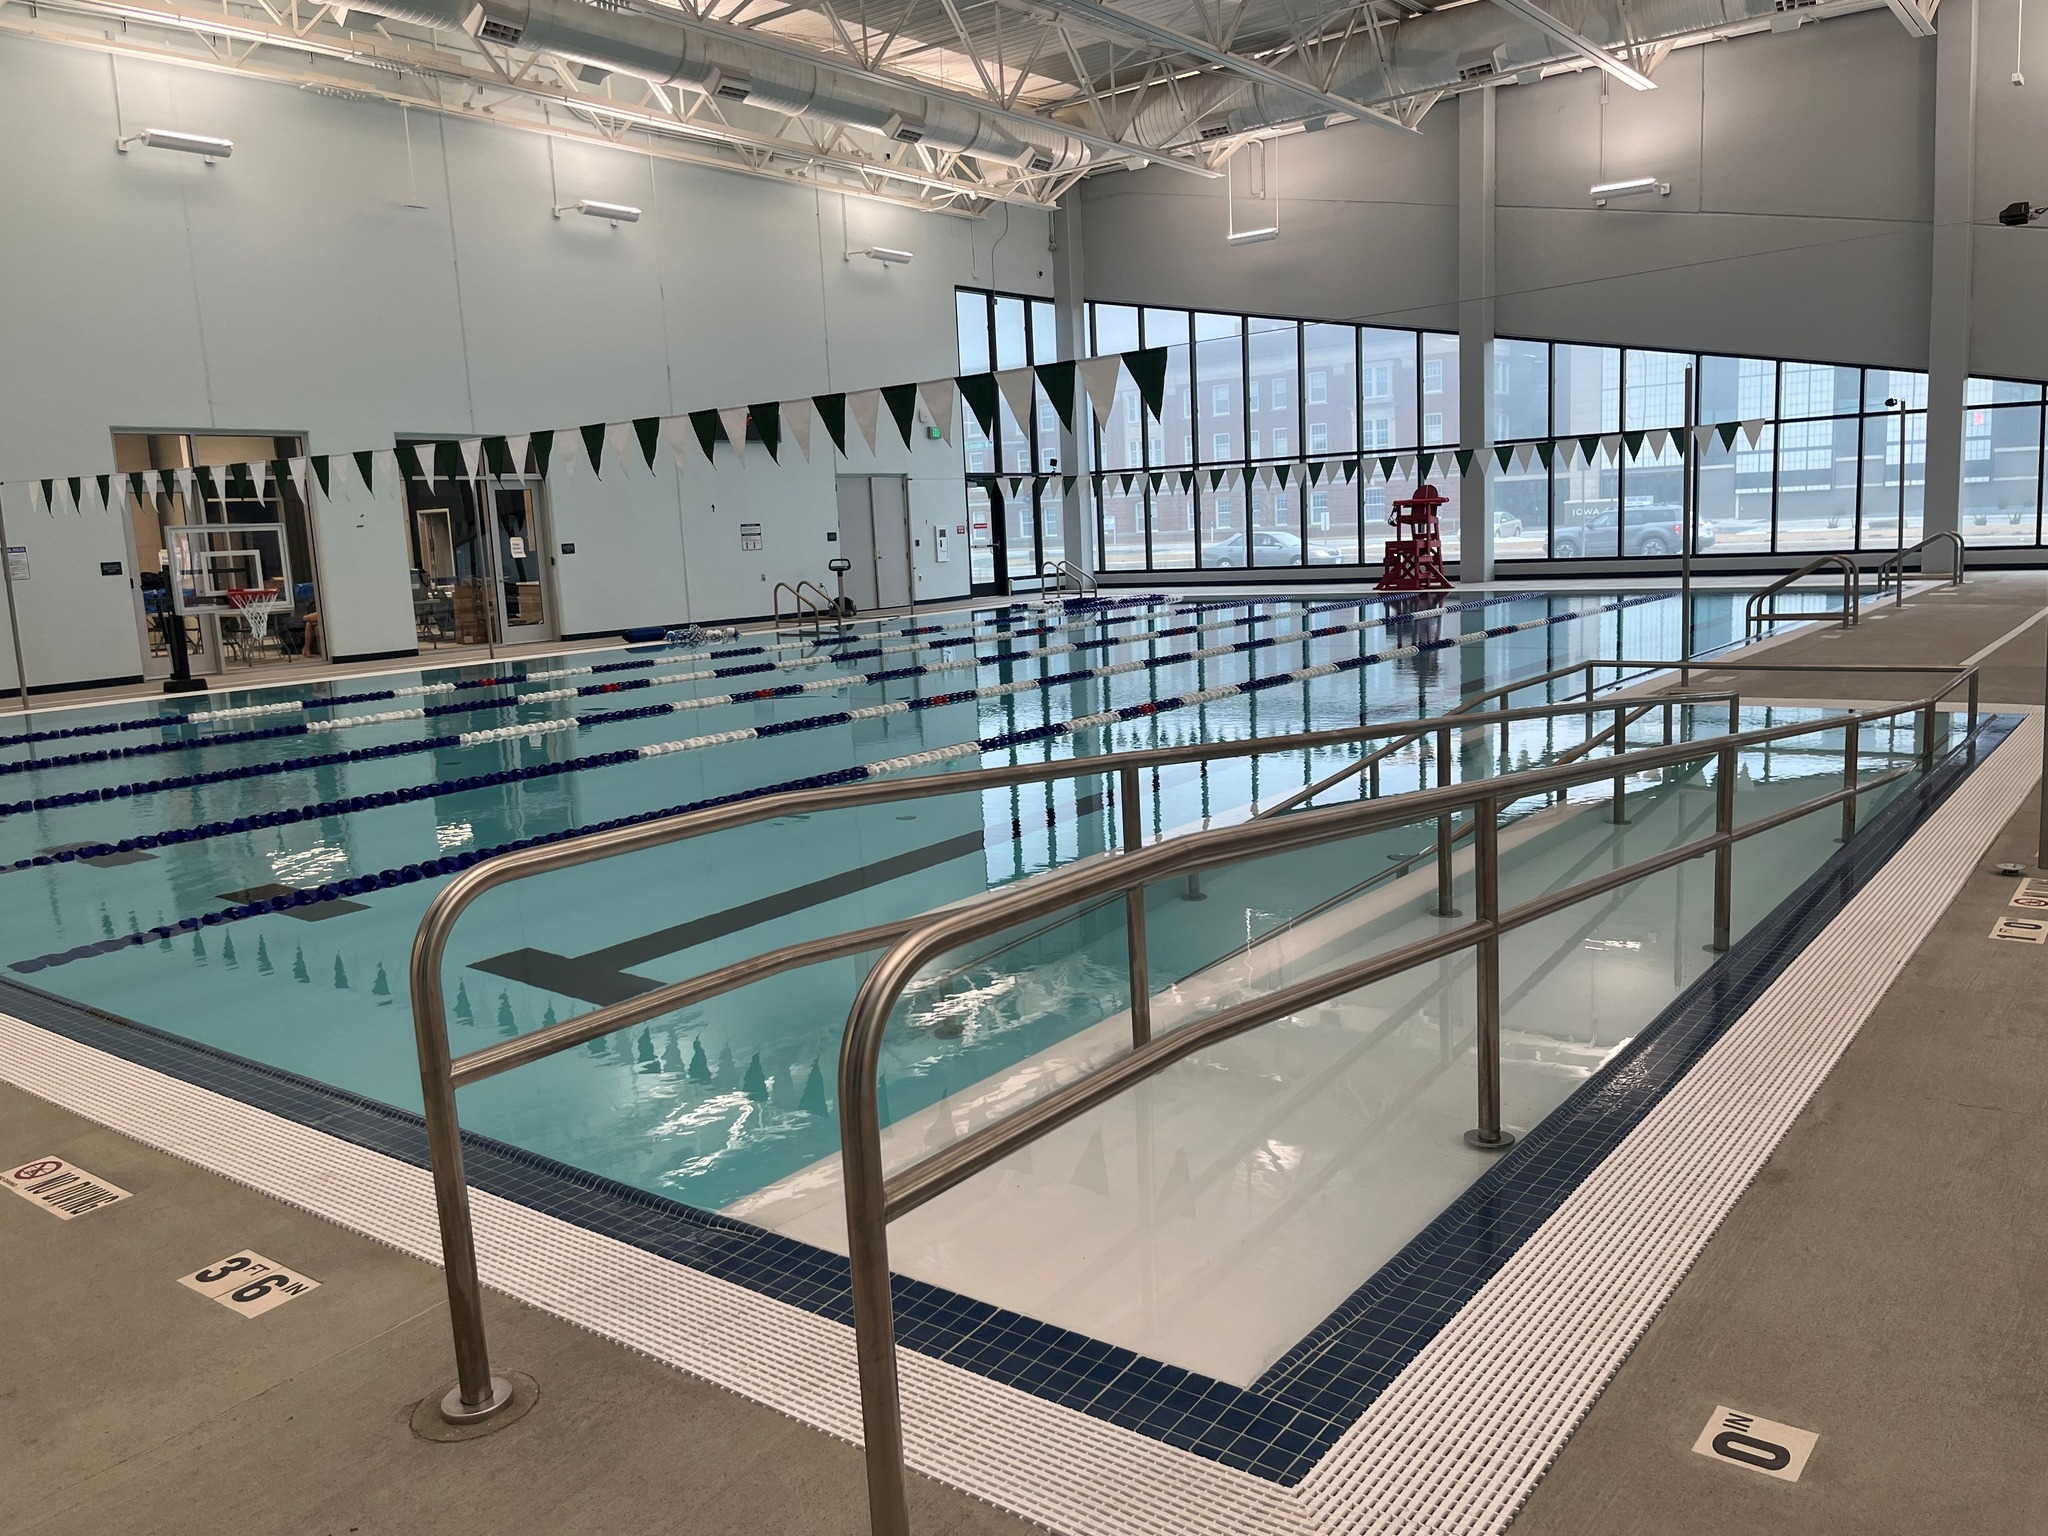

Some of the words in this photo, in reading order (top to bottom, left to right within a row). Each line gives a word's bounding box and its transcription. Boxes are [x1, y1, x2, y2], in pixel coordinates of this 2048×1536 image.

[1572, 508, 1600, 517] IOWA
[23, 1172, 80, 1195] NO
[41, 1181, 119, 1215] DIVING
